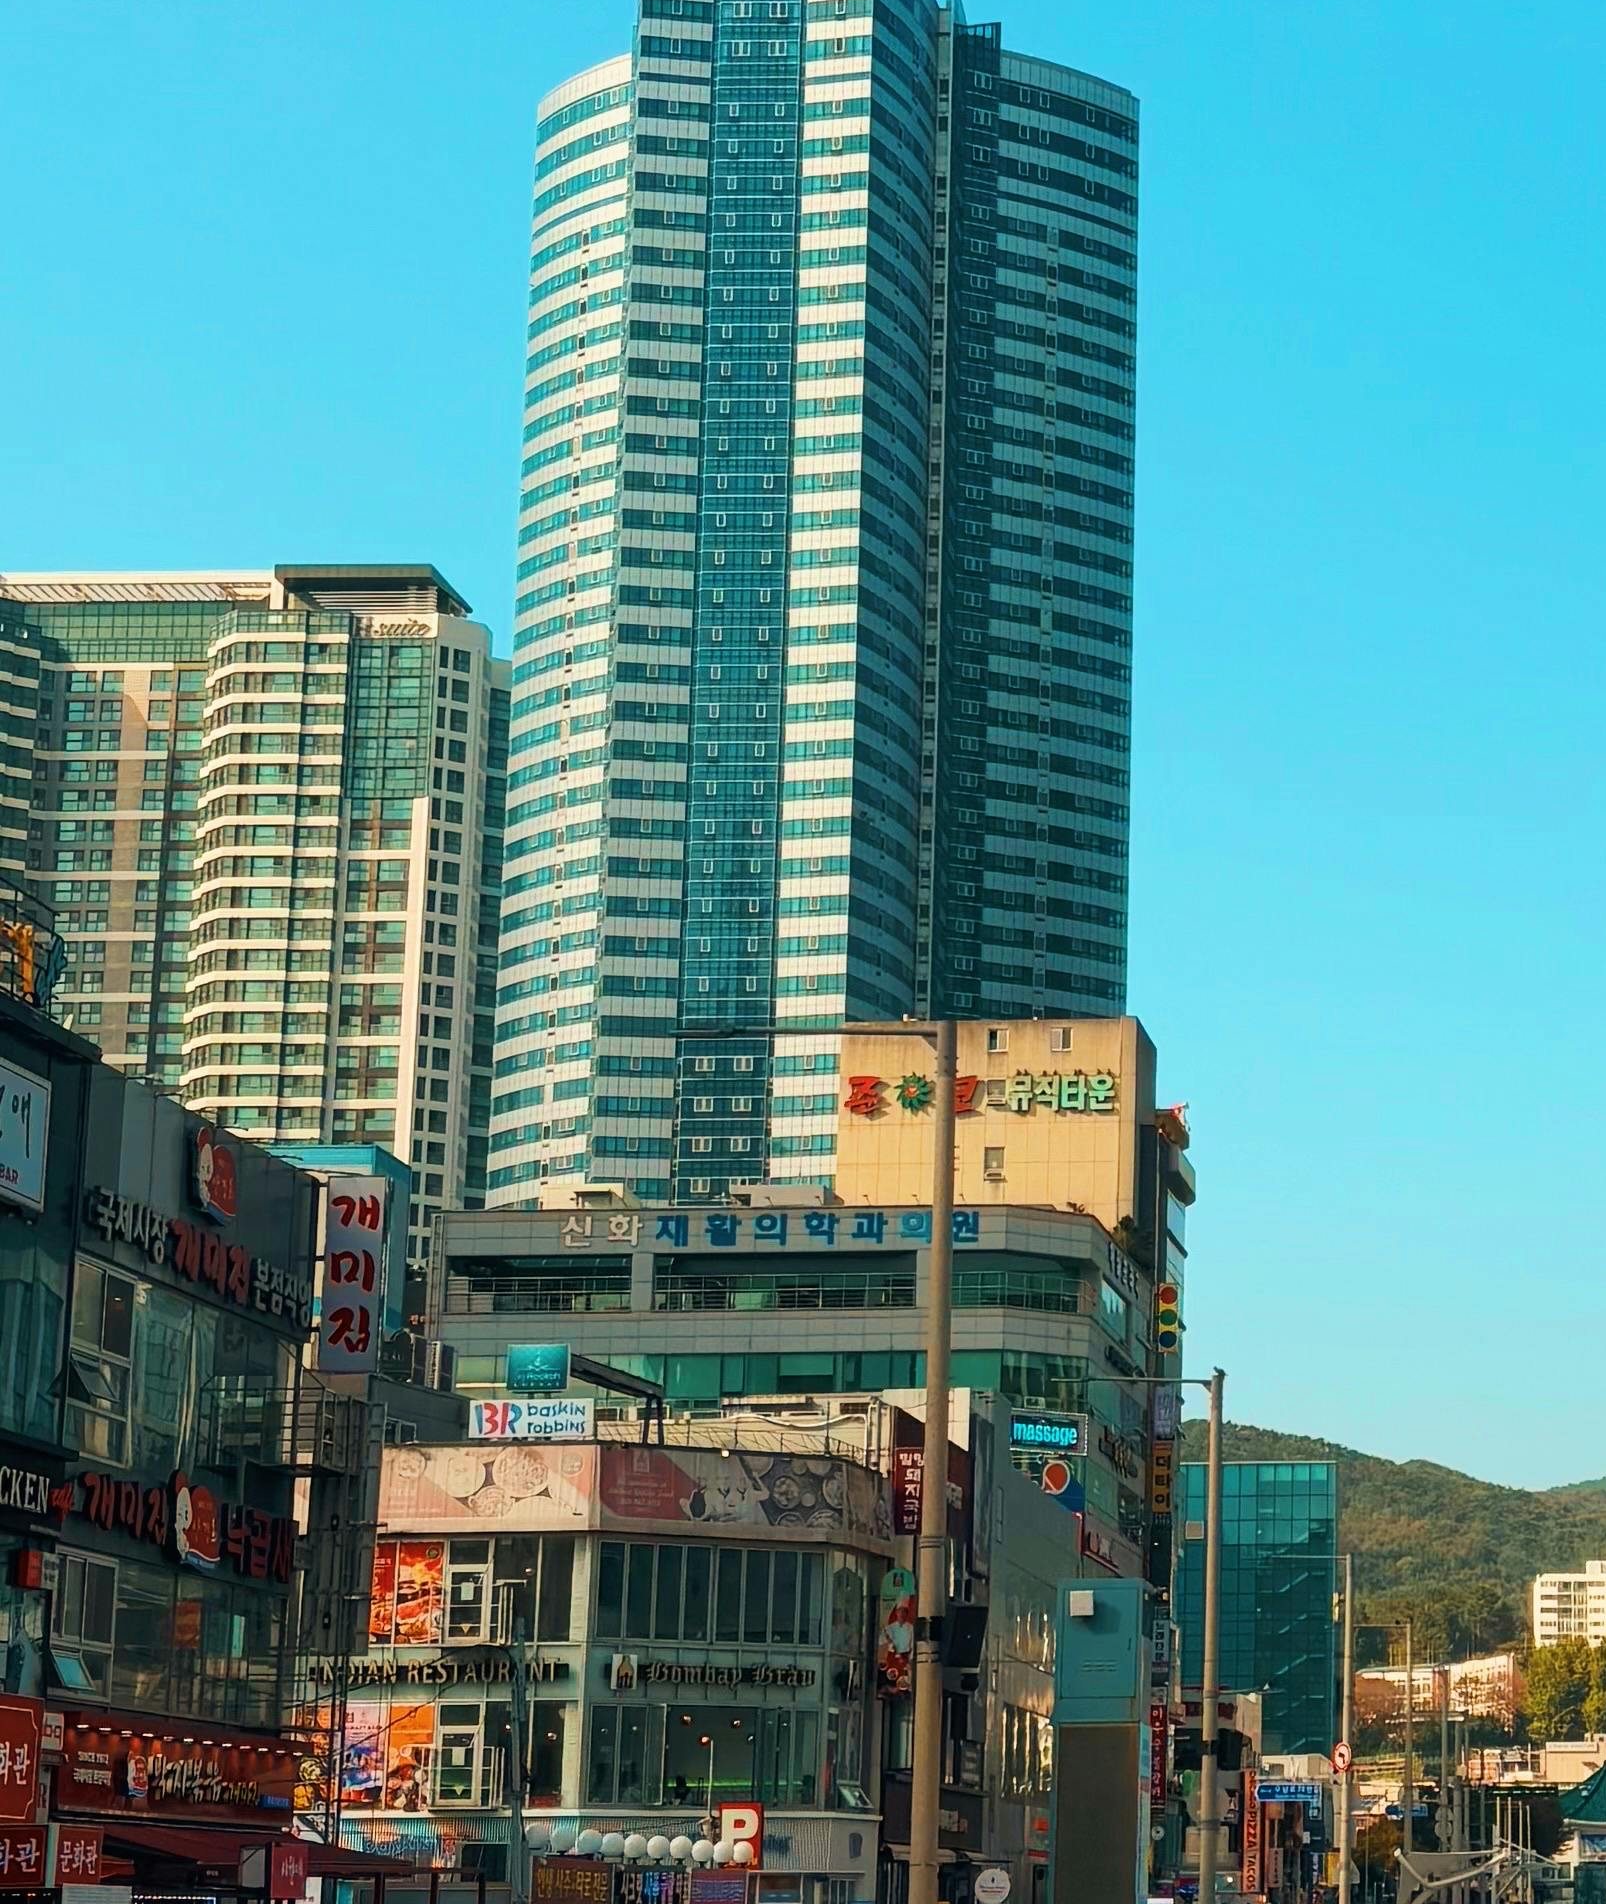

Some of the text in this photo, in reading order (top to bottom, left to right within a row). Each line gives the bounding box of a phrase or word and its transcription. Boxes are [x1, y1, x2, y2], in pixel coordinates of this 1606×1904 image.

[1007, 1074, 1115, 1112] 뮤직타운
[326, 1194, 381, 1354] 개미집
[526, 1400, 586, 1417] baskin
[526, 1418, 586, 1435] robbins
[1012, 1420, 1078, 1446] massage
[407, 1658, 560, 1685] RESTAURNT
[646, 1662, 743, 1691] Bombay
[59, 1839, 98, 1876] 문화관
